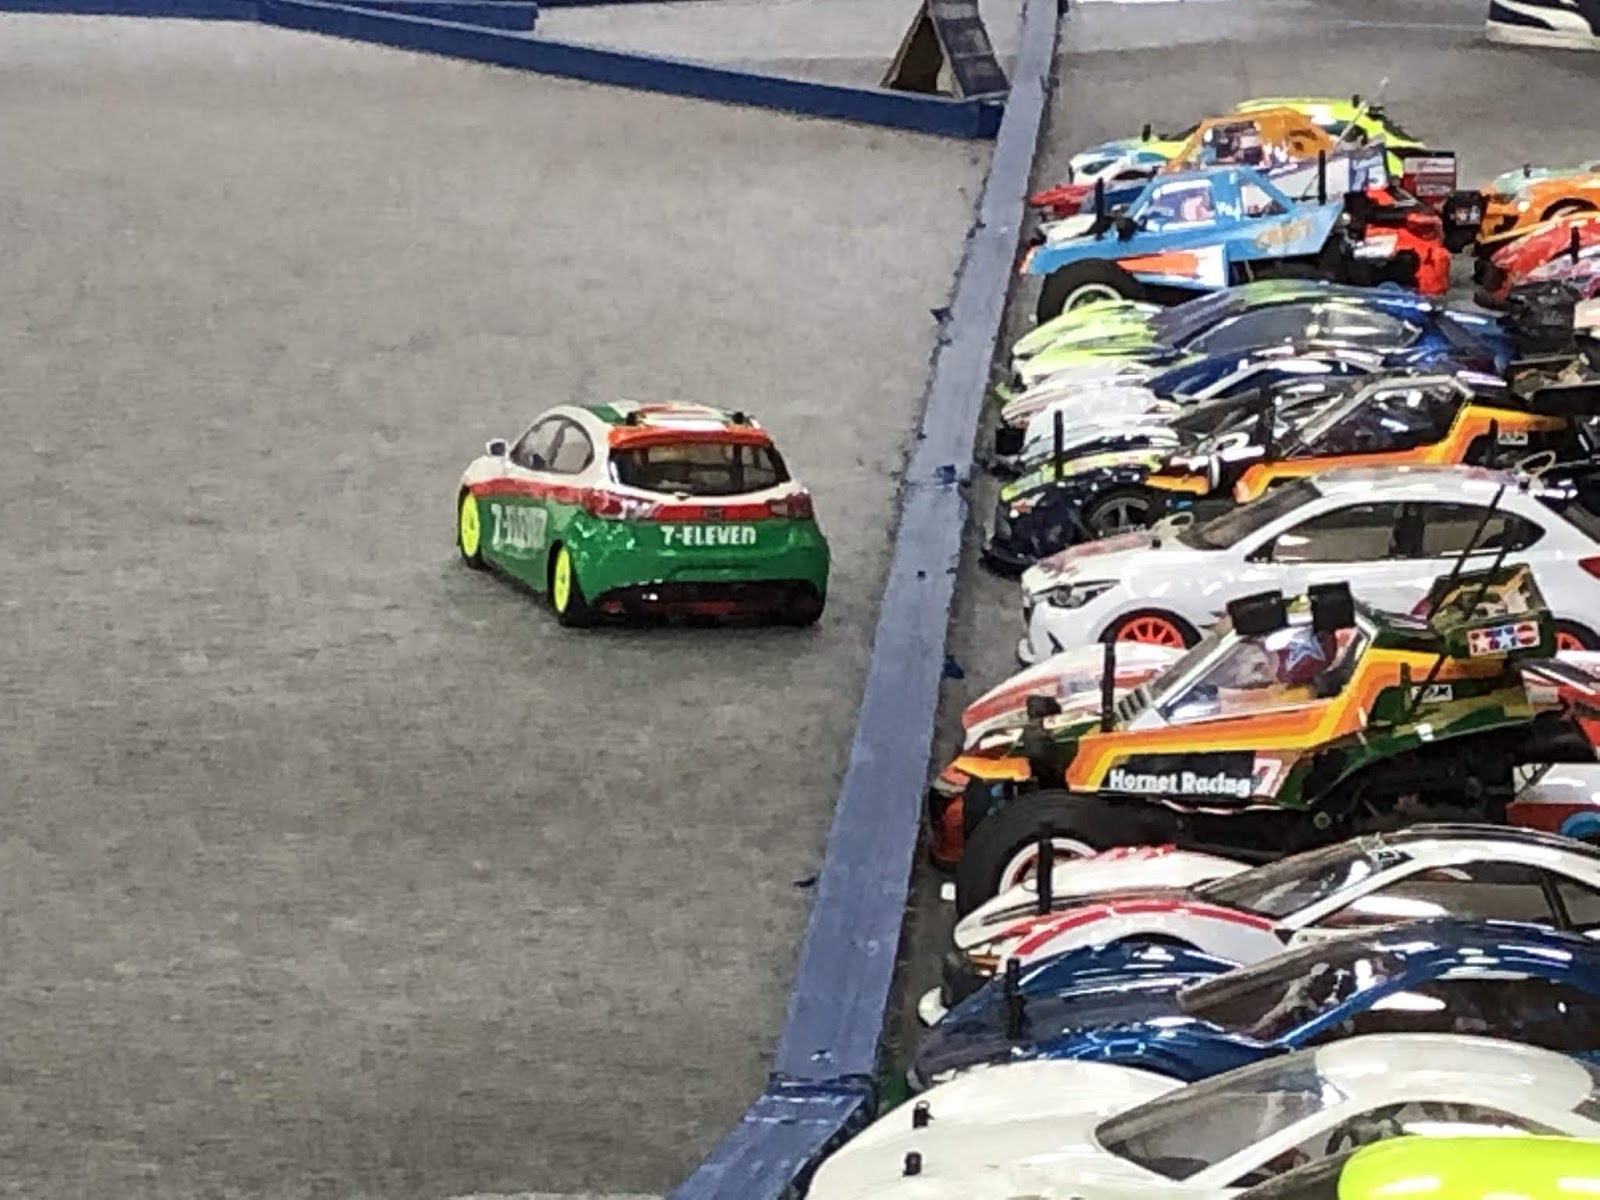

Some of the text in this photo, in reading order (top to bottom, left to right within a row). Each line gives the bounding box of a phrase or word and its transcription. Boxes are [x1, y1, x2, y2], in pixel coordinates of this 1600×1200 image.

[1109, 768, 1251, 798] Hornet Racing
[1252, 758, 1283, 796] 7
